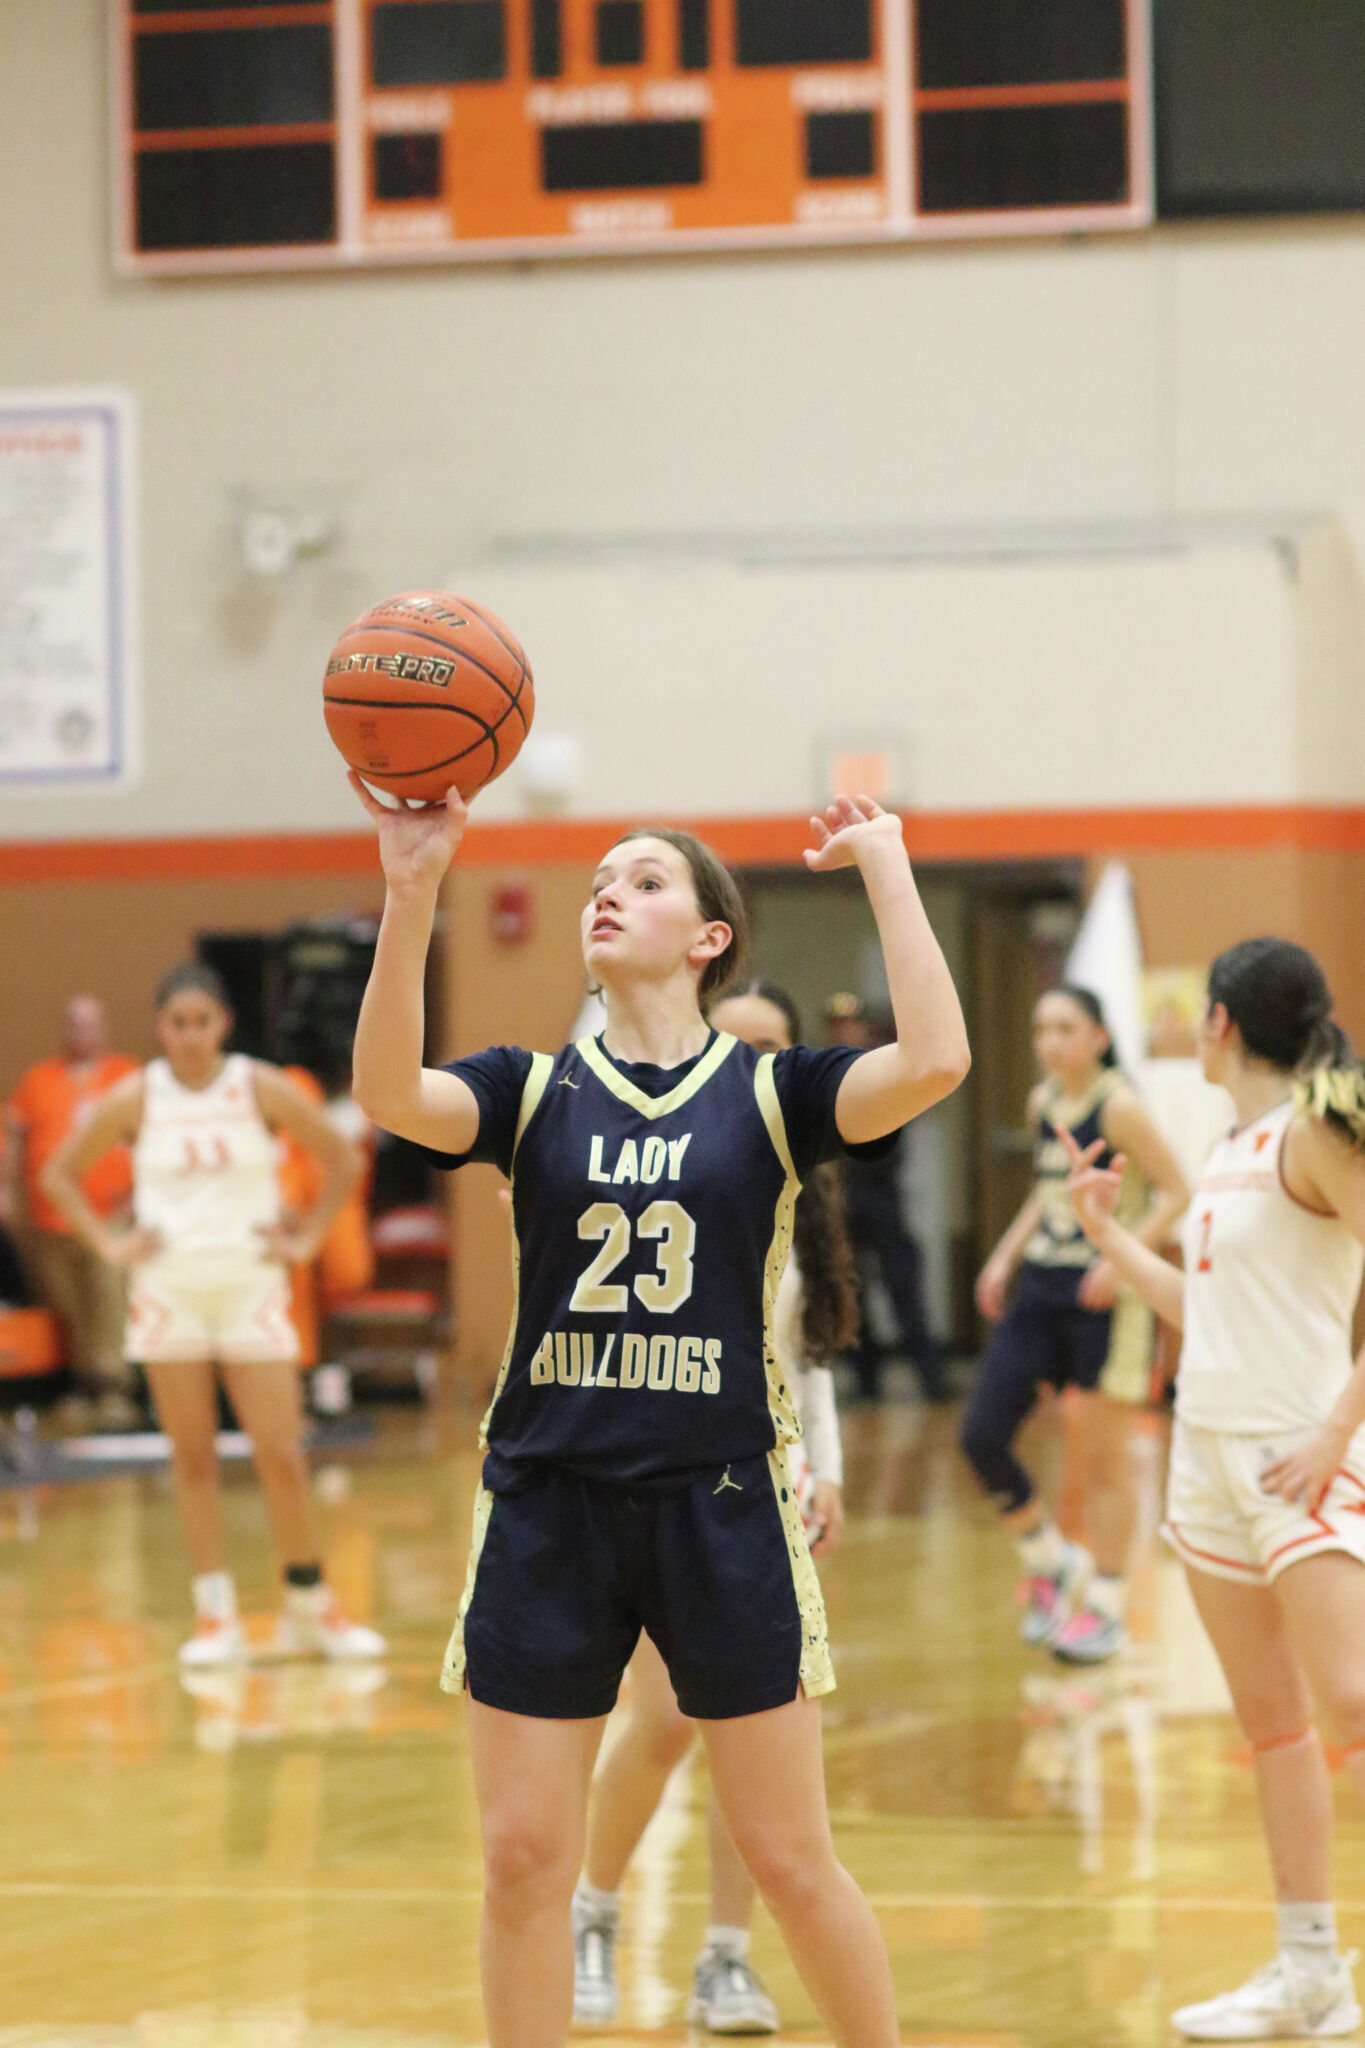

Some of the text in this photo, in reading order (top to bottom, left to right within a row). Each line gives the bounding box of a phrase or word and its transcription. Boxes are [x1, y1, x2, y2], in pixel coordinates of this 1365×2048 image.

[400, 657, 450, 685] PRO
[588, 1133, 692, 1184] LADY
[569, 1200, 696, 1313] 23
[530, 1331, 722, 1394] BULLDOGS
